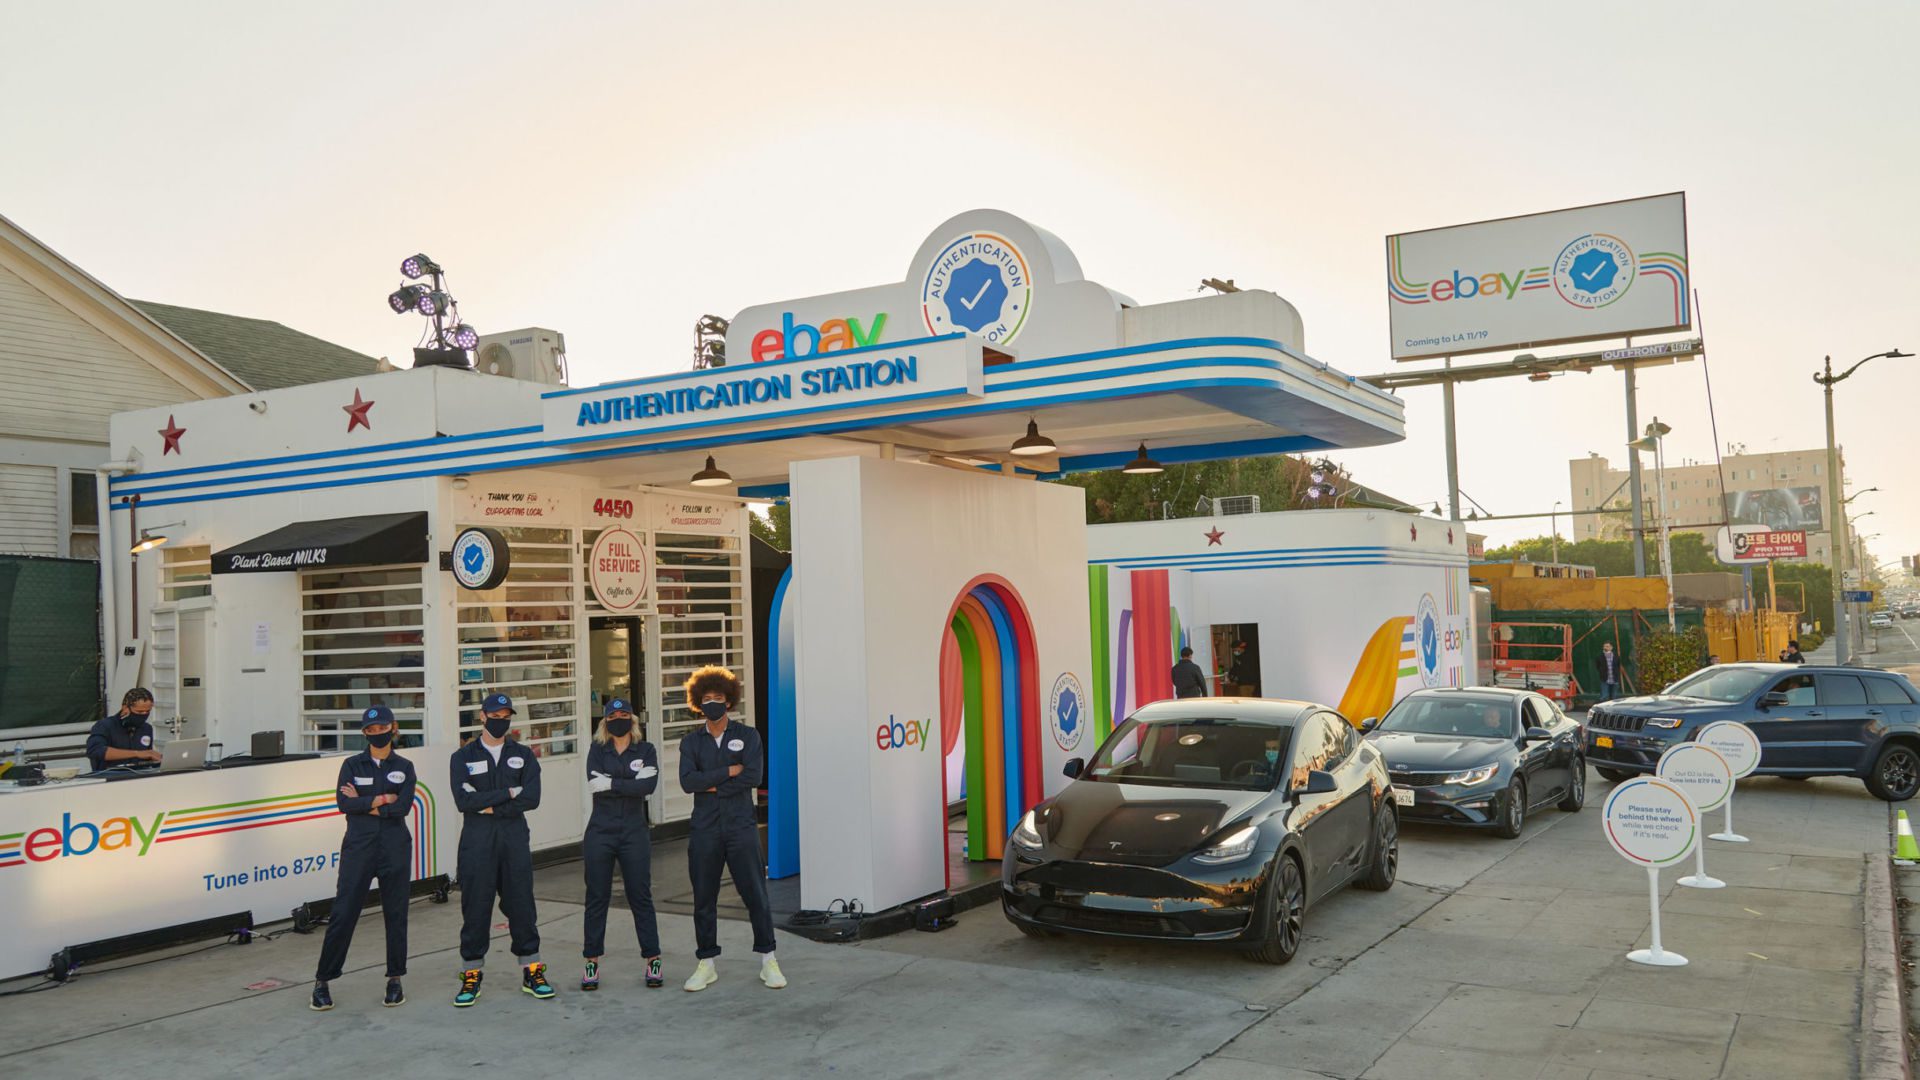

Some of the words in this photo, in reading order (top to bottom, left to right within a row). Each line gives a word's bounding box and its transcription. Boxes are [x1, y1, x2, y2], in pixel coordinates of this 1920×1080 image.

[1560, 239, 1629, 273] AUTHENTICATION
[931, 243, 1022, 298] AUTHENTICATION
[1431, 269, 1525, 301] ebay
[1572, 288, 1618, 304] STATION
[751, 312, 888, 362] ebay
[1405, 337, 1440, 347] Coming
[1441, 335, 1451, 344] to
[1453, 333, 1465, 342] LA
[1467, 330, 1488, 341] 11/19
[577, 375, 791, 427] AUTHENTICATION
[801, 356, 918, 396] STATION
[488, 493, 510, 501] THANK
[512, 493, 525, 501] YOU
[485, 507, 525, 516] SUPPORTING
[526, 508, 544, 516] LOCAL
[593, 498, 633, 519] 4450
[682, 505, 703, 513] FOLLOW
[231, 555, 261, 569] Plant
[261, 552, 295, 567] Based
[294, 548, 327, 564] MILKS
[608, 543, 632, 557] FULL
[600, 558, 640, 573] SERVICE
[606, 587, 624, 598] Coffee
[1445, 623, 1464, 656] ebay
[1053, 677, 1083, 710] AUTHENTICATION
[876, 714, 931, 752] ebay
[1059, 731, 1079, 746] STATION
[1629, 805, 1654, 813] Please
[1655, 807, 1672, 815] stay
[24, 812, 165, 862] ebay
[203, 873, 249, 891] Tune
[253, 864, 288, 882] into
[293, 854, 326, 875] 87.9
[331, 852, 341, 868] F
